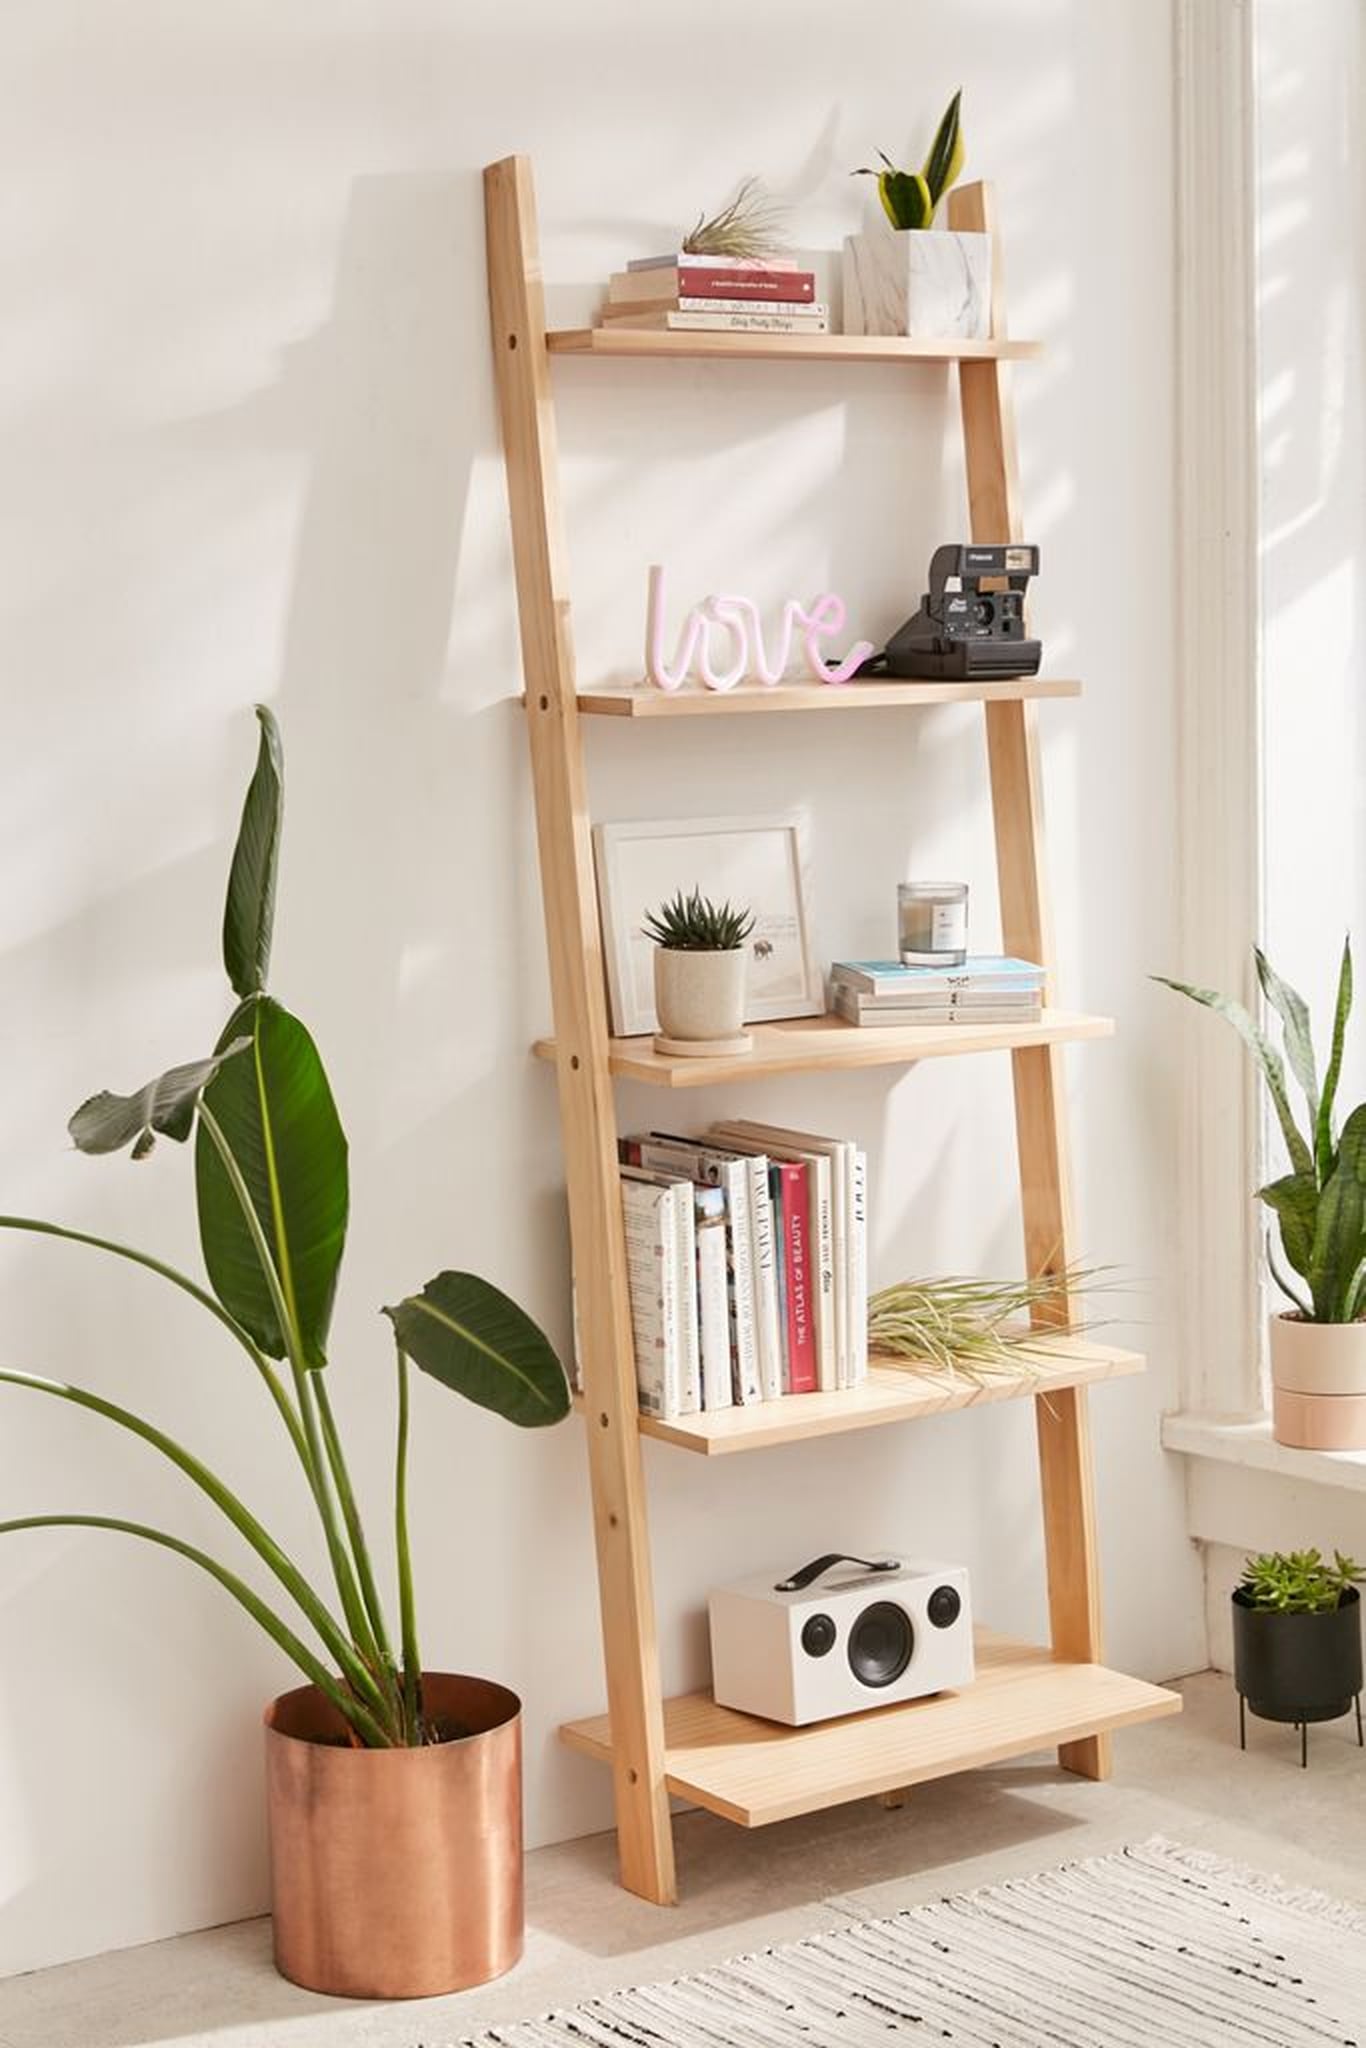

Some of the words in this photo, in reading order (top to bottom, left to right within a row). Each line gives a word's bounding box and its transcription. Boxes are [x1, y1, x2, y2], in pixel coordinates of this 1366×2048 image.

[648, 564, 874, 690] love
[791, 1214, 803, 1263] BEAUTY
[793, 1267, 803, 1281] OF
[794, 1284, 806, 1324] ATLAS
[797, 1325, 807, 1345] THE
